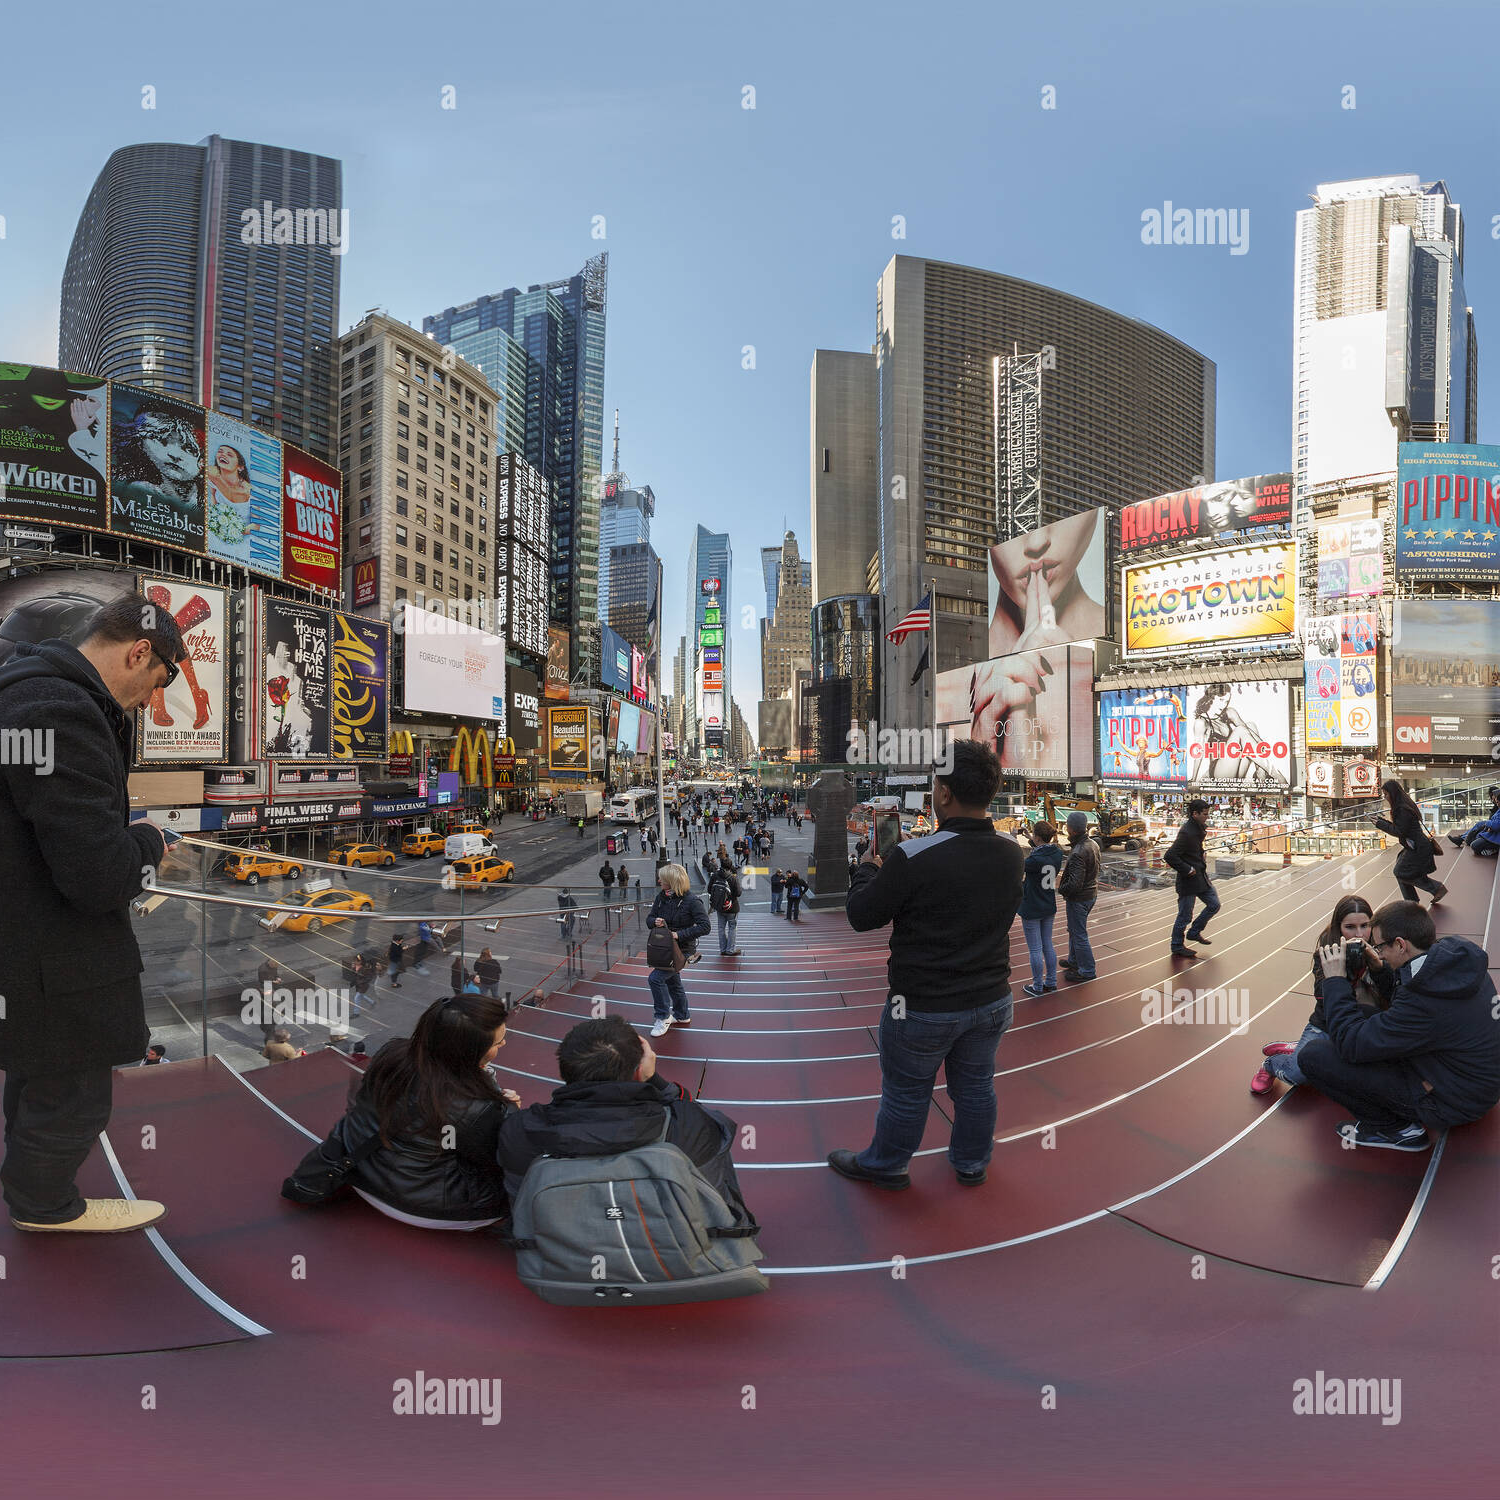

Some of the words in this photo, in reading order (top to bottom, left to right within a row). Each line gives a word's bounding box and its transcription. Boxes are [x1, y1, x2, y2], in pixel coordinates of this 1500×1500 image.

[128, 387, 159, 400] MUSICAL
[209, 425, 231, 439] LOVE
[500, 455, 509, 475] OPEN
[1461, 460, 1499, 468] MUSICAL
[285, 470, 339, 516] JERSEY
[513, 467, 522, 519] EXPRESS
[1255, 483, 1290, 497] LOVE
[147, 494, 170, 513] Les
[499, 478, 509, 520] EXPRESS
[1255, 494, 1290, 508] WINS
[1402, 474, 1500, 528] PIPPIN
[295, 502, 334, 542] BOYS
[1121, 488, 1203, 543] ROCKY
[1121, 526, 1200, 550] BROADWAY
[309, 551, 332, 560] CROWD
[499, 546, 507, 571] OPEN
[498, 575, 507, 626] EXPRESS
[1130, 574, 1285, 619] MOTOWN
[1220, 602, 1285, 618] MUSICAL.
[293, 618, 327, 641] HOLLER
[299, 635, 312, 649] IF
[313, 637, 326, 656] YA
[190, 648, 221, 663] Boots
[295, 649, 323, 666] HEAR
[419, 651, 447, 665] FORECAST
[449, 659, 462, 669] YOUR
[1342, 659, 1375, 667] PURPLE
[304, 664, 325, 680] ME
[1308, 702, 1333, 710] LIGHT
[146, 731, 174, 740] WINNER!
[174, 731, 179, 740] 6
[180, 731, 195, 740] TONY
[196, 731, 220, 740] AWARDS
[553, 725, 585, 734] Beautiful
[1108, 717, 1181, 750] PIPPIN
[1396, 726, 1429, 743] CNN
[1190, 741, 1288, 760] CHICAGO
[220, 773, 244, 784] Annie
[279, 773, 301, 783] Annie
[309, 772, 328, 782] Annie
[337, 772, 355, 782] Annie
[228, 811, 257, 824] Annie
[264, 807, 297, 817] FINAL
[299, 804, 333, 815] WEEKS
[338, 804, 362, 816] Annie
[373, 804, 395, 812] MONEY
[396, 801, 427, 811] EXCHANGE
